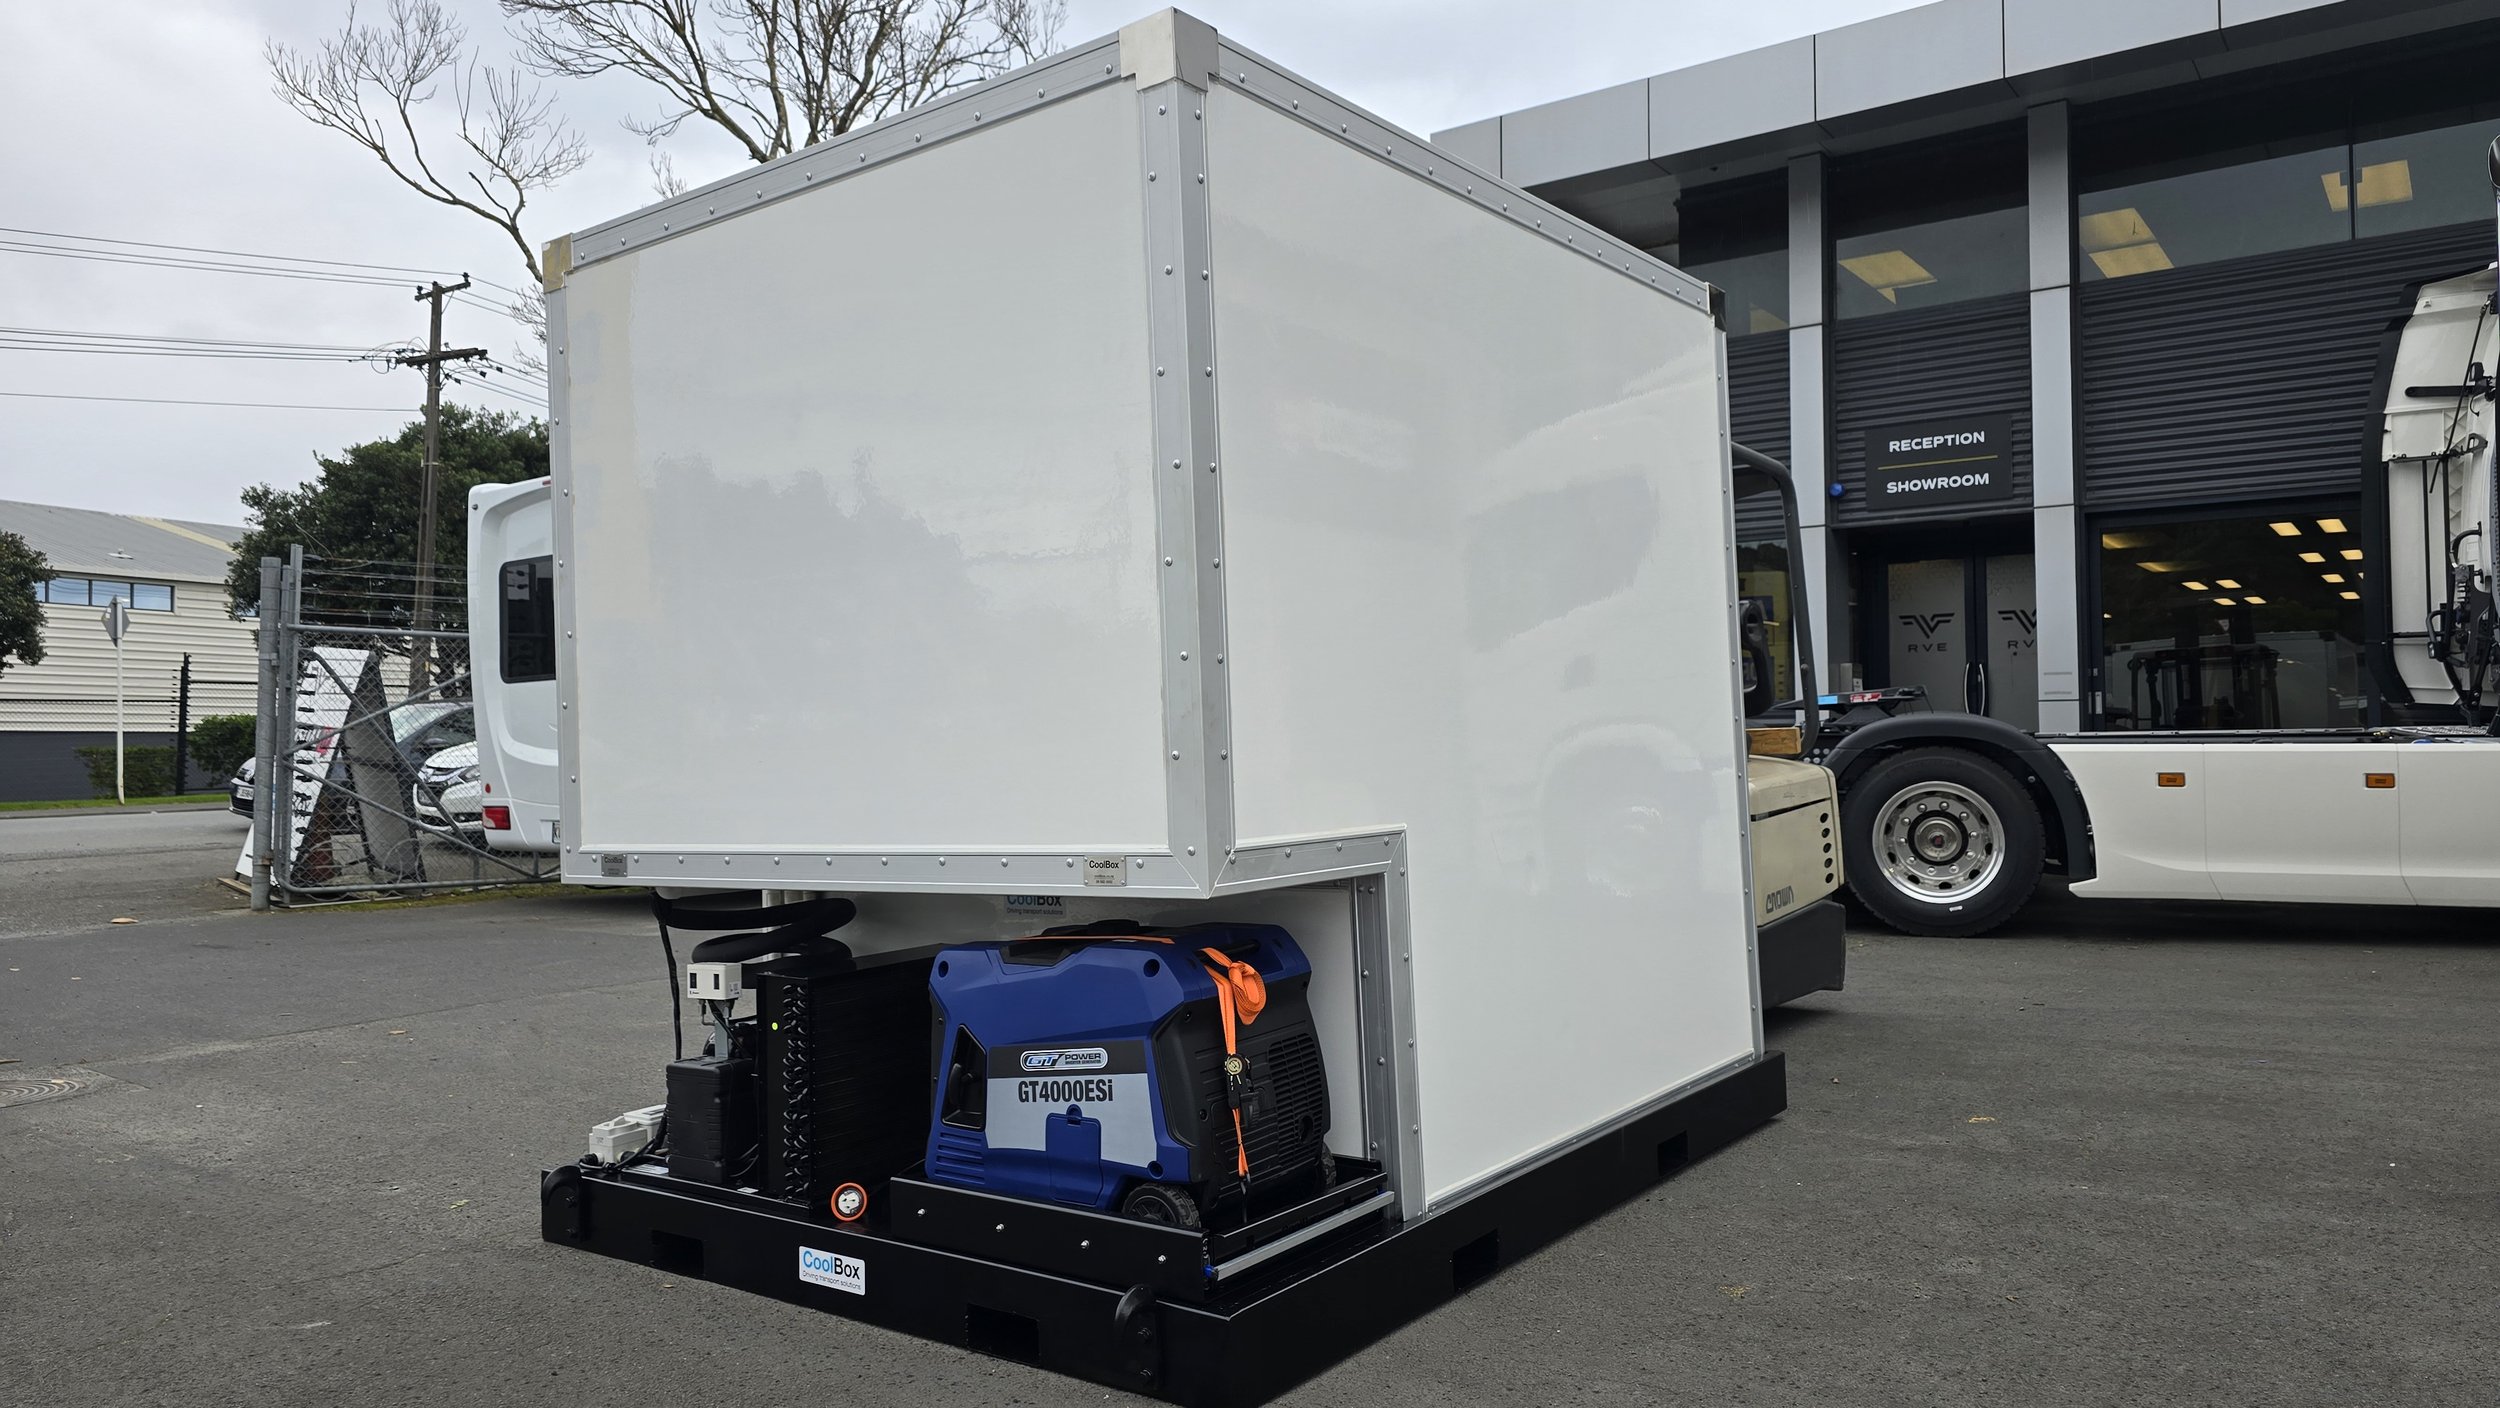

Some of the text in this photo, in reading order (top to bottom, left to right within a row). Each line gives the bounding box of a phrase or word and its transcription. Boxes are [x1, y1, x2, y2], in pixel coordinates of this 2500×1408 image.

[1889, 430, 1985, 452] RECEPTION
[1886, 472, 1990, 494] SHOWROOM
[1908, 642, 1948, 653] RVE
[2008, 639, 2036, 649] RV
[1089, 860, 1119, 869] CoolBox
[1064, 1053, 1102, 1061] POWER
[1018, 1079, 1114, 1103] GT4000ESi
[803, 1251, 860, 1280] CoolBox
[802, 1270, 818, 1281] Driving
